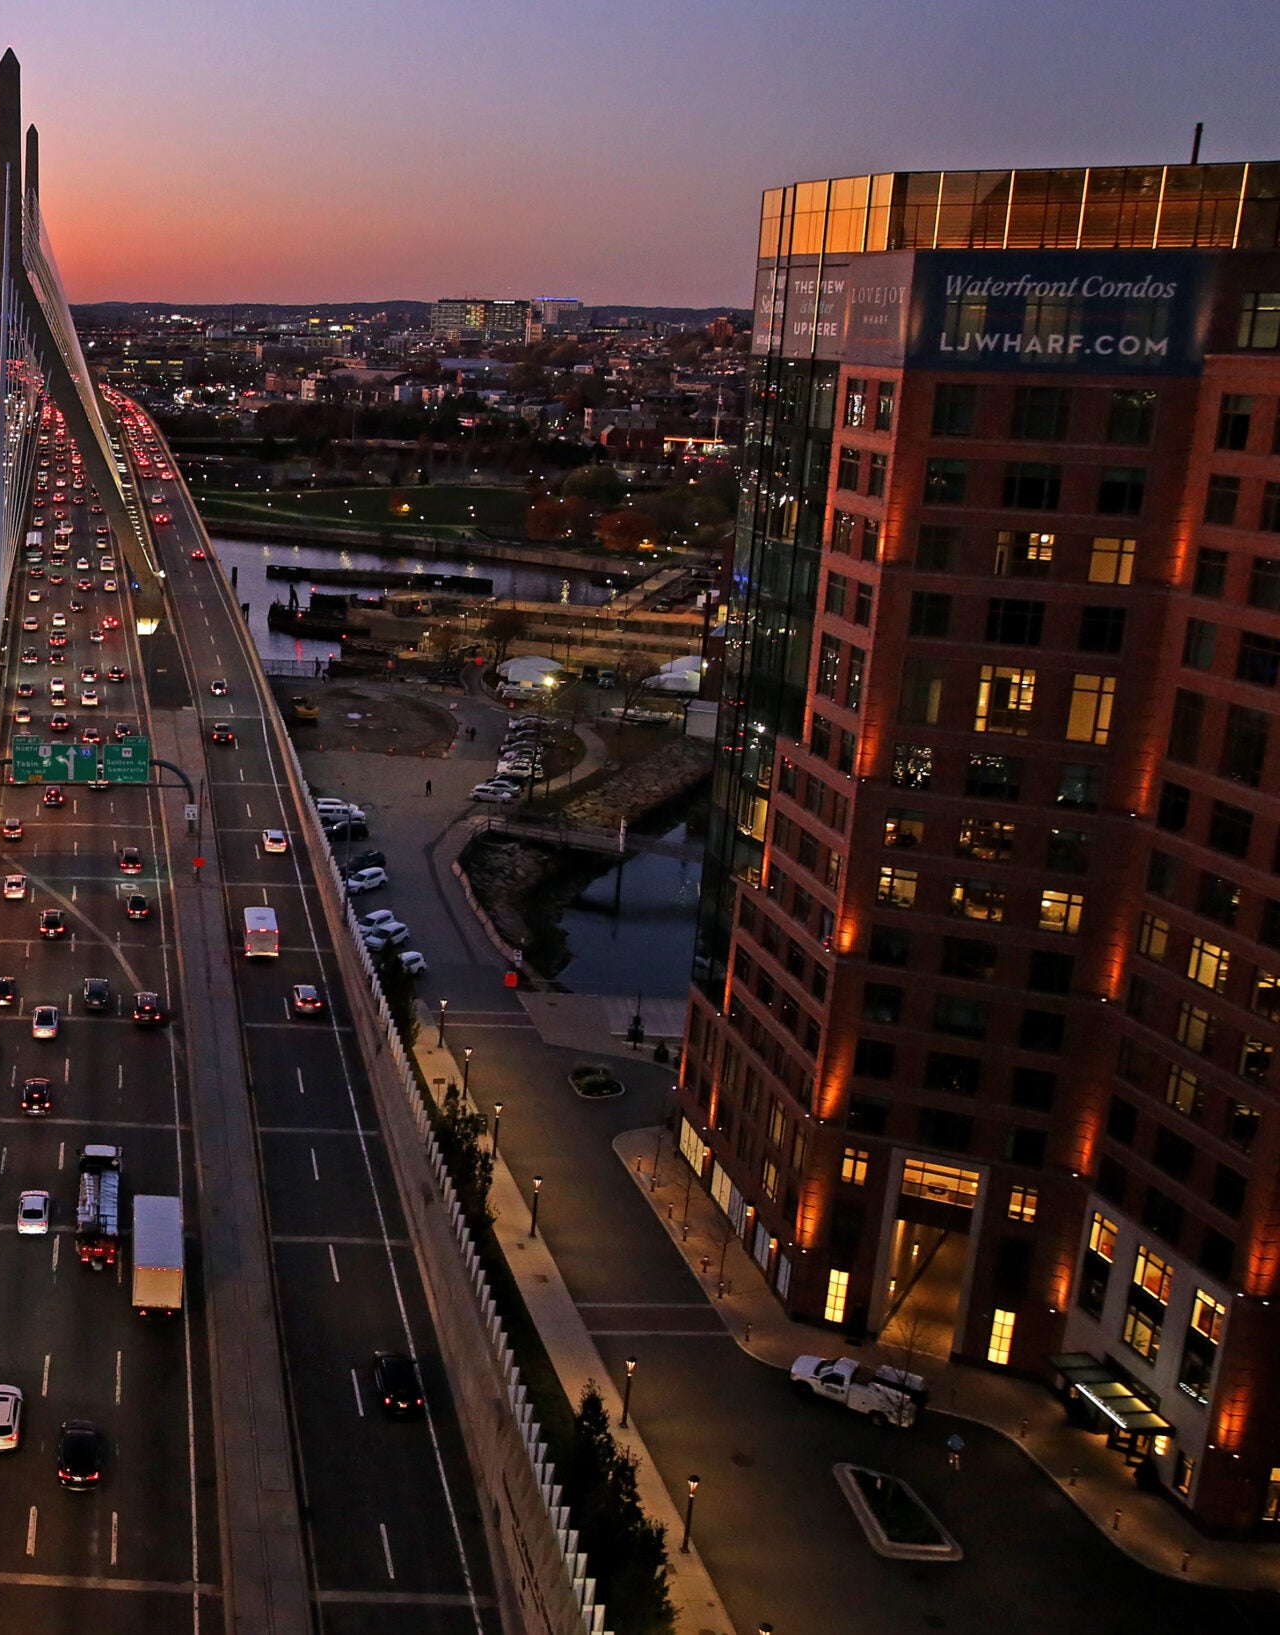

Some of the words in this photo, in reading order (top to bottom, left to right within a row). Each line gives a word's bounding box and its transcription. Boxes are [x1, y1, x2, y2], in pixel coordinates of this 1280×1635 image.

[794, 281, 814, 294] THE
[945, 274, 1079, 297] Waterfront
[1082, 274, 1178, 298] Condos
[851, 287, 907, 307] LOVEJOY
[793, 321, 808, 335] UP
[863, 315, 889, 324] WHARF
[939, 332, 1169, 356] LJWHARF.COM
